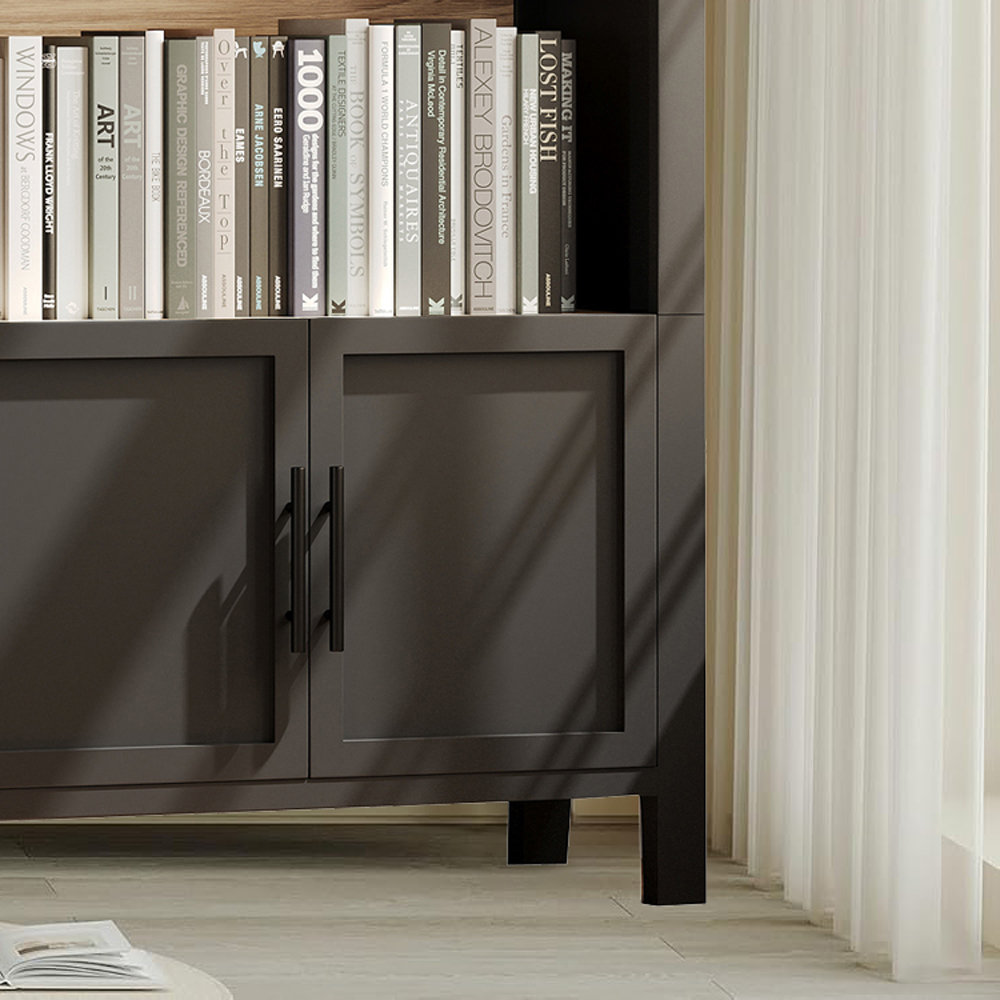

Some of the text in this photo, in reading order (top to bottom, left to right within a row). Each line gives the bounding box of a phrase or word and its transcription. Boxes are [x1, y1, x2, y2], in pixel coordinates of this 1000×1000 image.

[15, 46, 36, 162] WINDOWS
[297, 48, 324, 132] 1000
[338, 50, 346, 137] TEXTILE DESIGNERS
[425, 50, 435, 82] Virginia
[474, 26, 493, 125] ALEXEY
[539, 38, 557, 162] LOST FISH
[561, 52, 572, 143] MAKING IT
[97, 104, 115, 148] ART
[124, 103, 141, 148] ART
[235, 128, 245, 163] EAMES
[254, 104, 264, 187] ARNE JACOBSEN
[273, 108, 283, 188] EERO SAARINEN
[310, 133, 319, 159] designs
[349, 91, 364, 148] BOOK
[437, 50, 447, 244] Detail in Contemporary Residential Architecture
[529, 89, 537, 194] NEW URBAN HOUSING
[20, 174, 30, 221] BERGDORF
[45, 132, 54, 234] FRANK LLOYD WRIGHT
[175, 64, 188, 267] GRAPHIC DESIGN REFERENCED
[198, 150, 211, 223] BORDEAUX
[301, 192, 310, 214] Rudge
[310, 184, 319, 211] gardens
[404, 99, 419, 243] ANTIQUAIRES
[500, 115, 512, 239] Gardens in France
[20, 222, 30, 271] GOODMAN
[349, 173, 364, 278] SYMBOLS
[474, 134, 493, 298] BRODOVITCH
